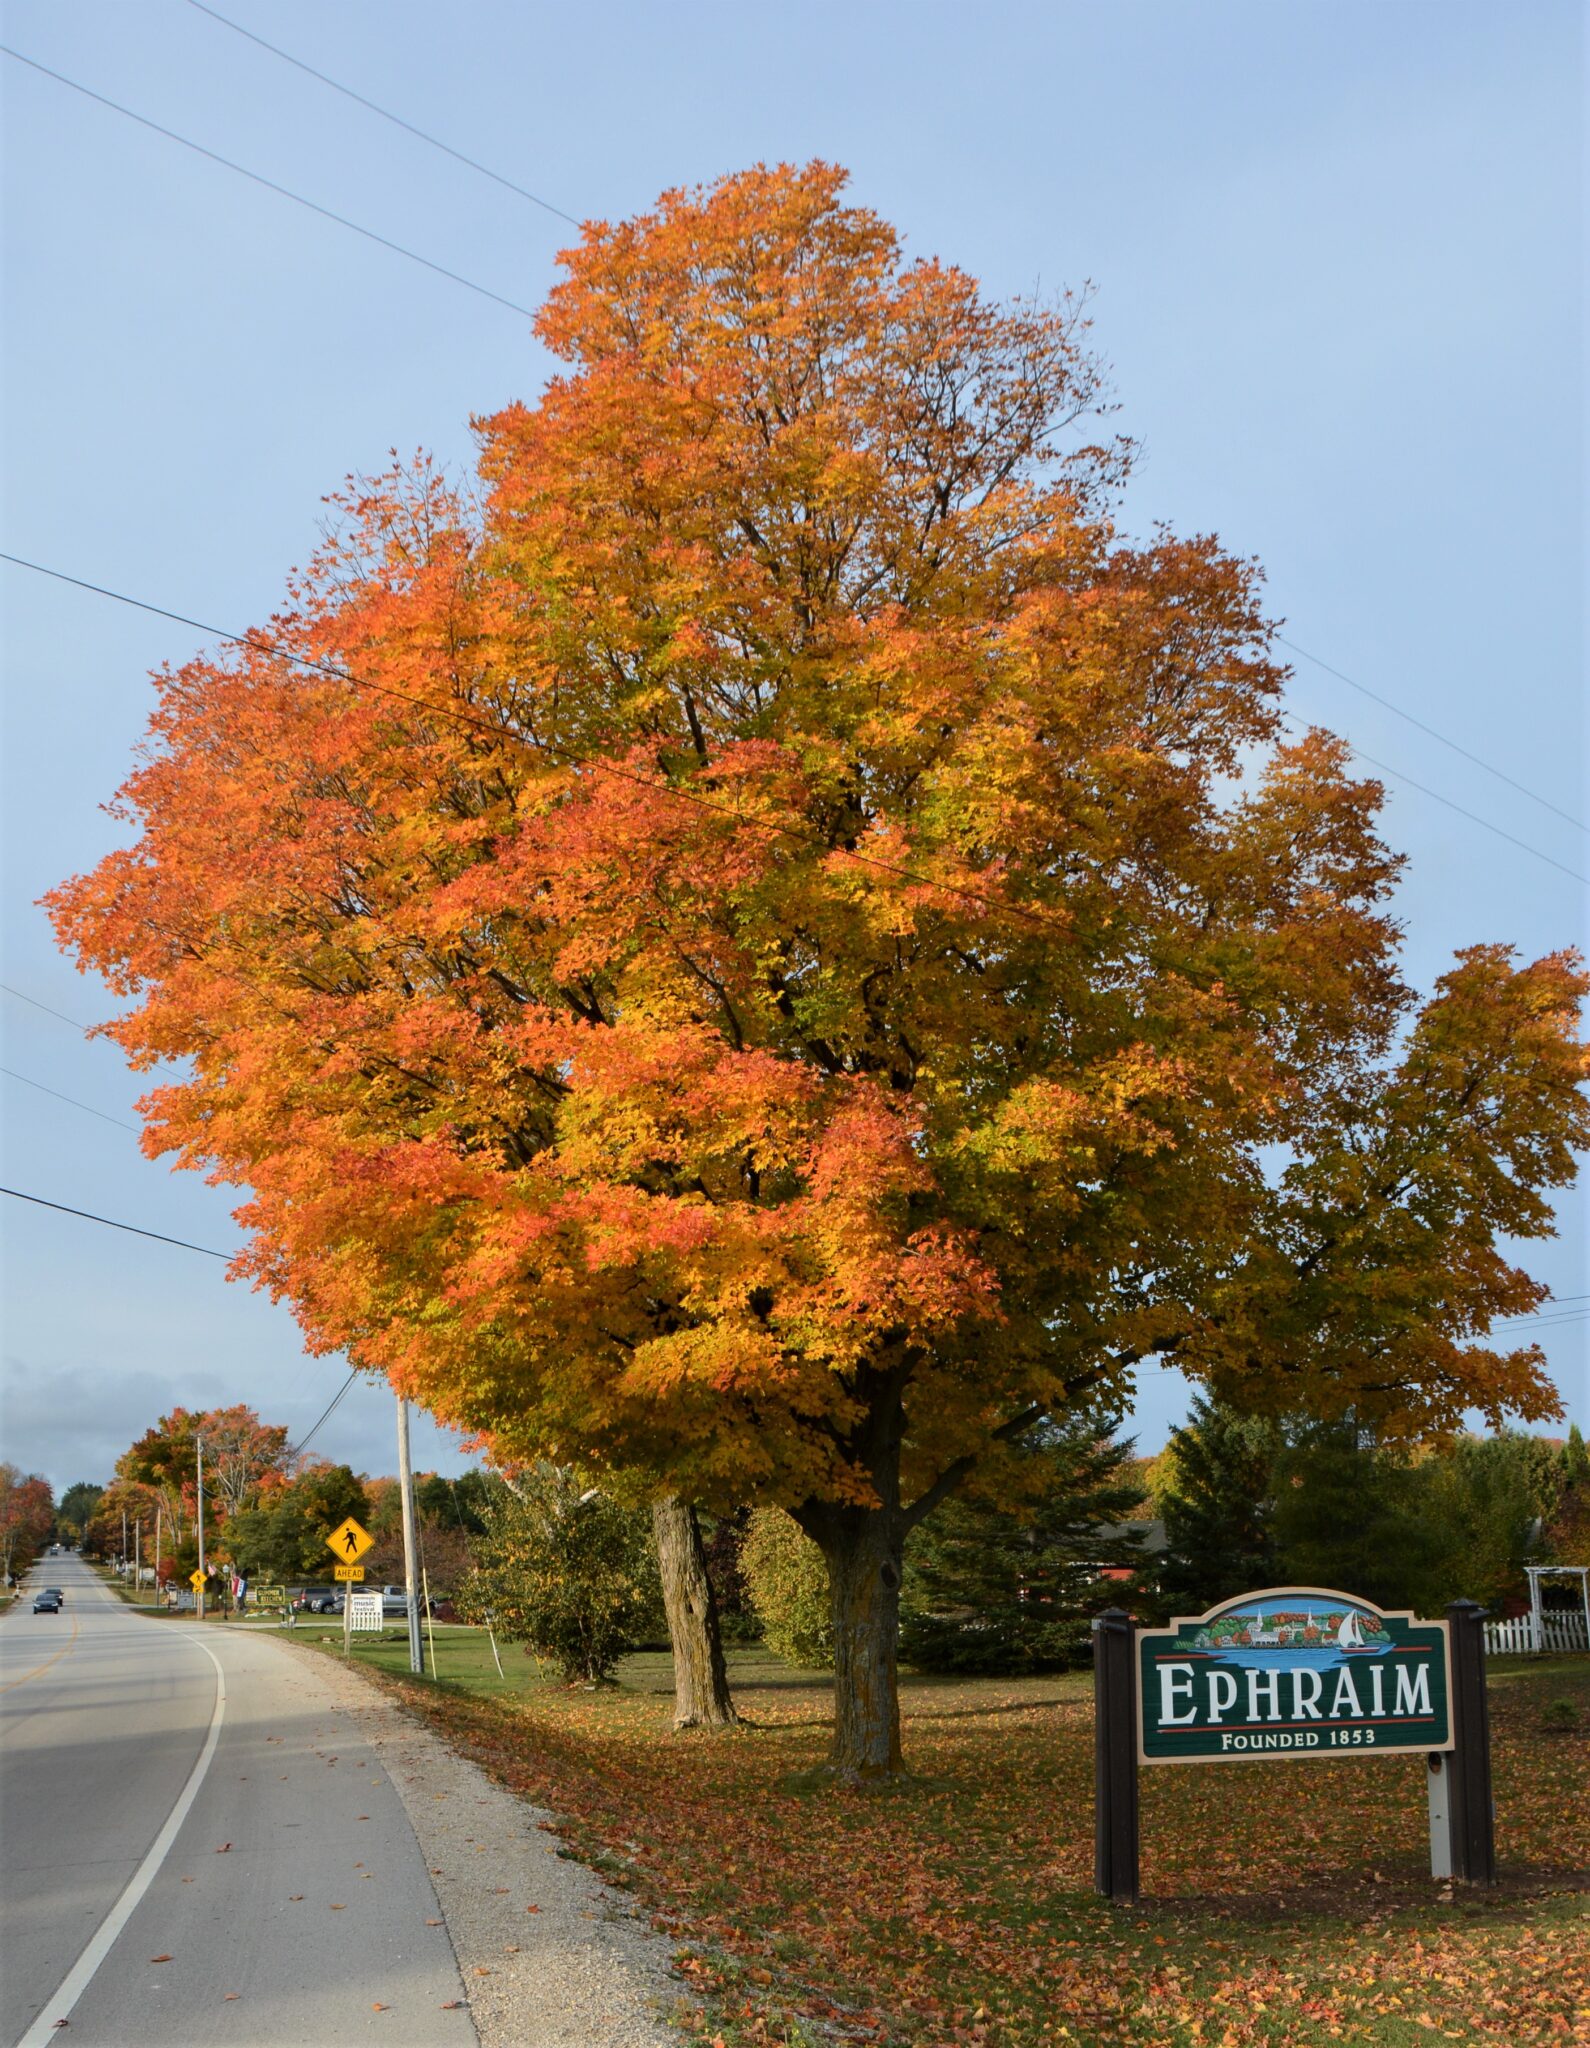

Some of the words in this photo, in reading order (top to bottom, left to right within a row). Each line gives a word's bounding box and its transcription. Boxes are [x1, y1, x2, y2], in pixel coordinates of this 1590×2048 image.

[337, 1569, 362, 1578] AHEAD
[1156, 1662, 1434, 1725] EPHRAIM
[1221, 1733, 1319, 1750] FOUNDED
[1330, 1729, 1375, 1745] 1853
